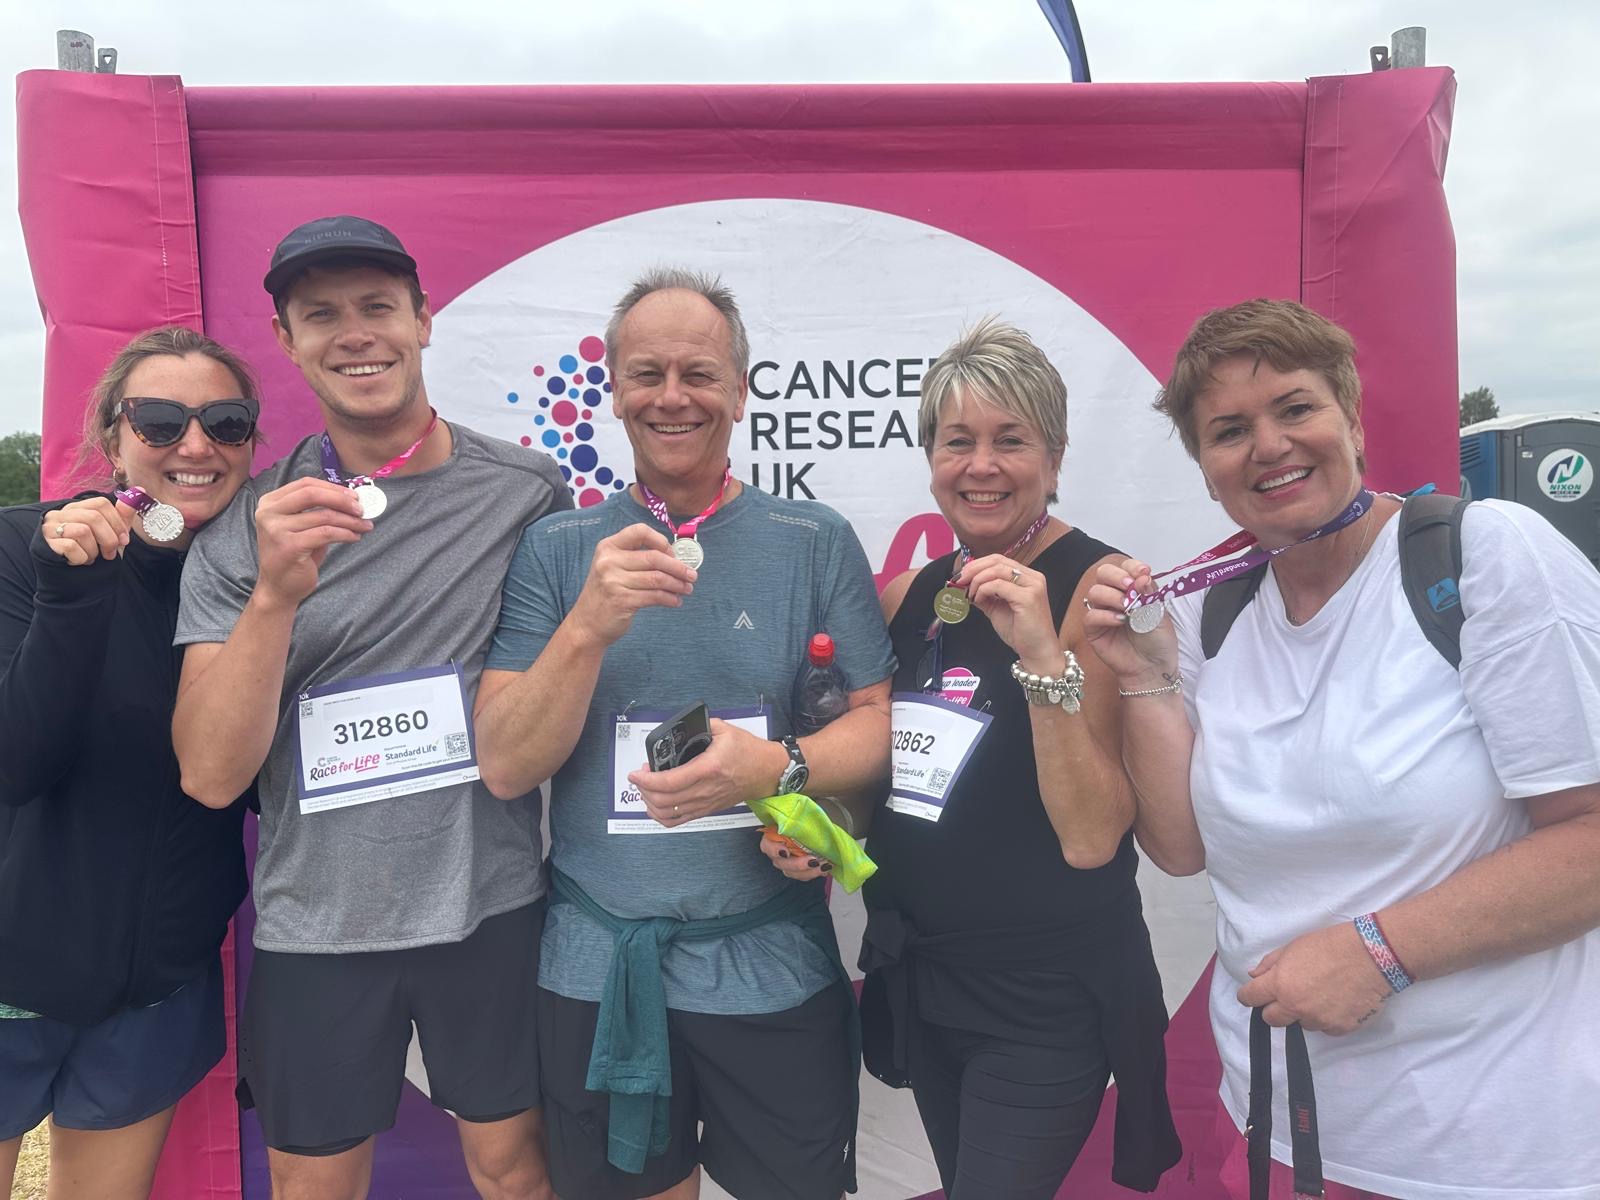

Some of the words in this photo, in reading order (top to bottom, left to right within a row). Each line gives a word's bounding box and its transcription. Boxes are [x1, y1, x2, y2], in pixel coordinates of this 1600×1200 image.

[748, 358, 938, 400] CANCE
[750, 409, 924, 450] RESEA
[752, 462, 816, 499] UK
[1205, 570, 1220, 580] Life
[1218, 561, 1249, 576] Standard
[952, 678, 977, 687] leader
[333, 710, 428, 745] 312860
[385, 747, 422, 761] Standard
[422, 743, 437, 754] Life
[310, 765, 338, 781] Race
[338, 762, 354, 773] for
[354, 752, 381, 772] Life
[620, 790, 642, 804] Rac
